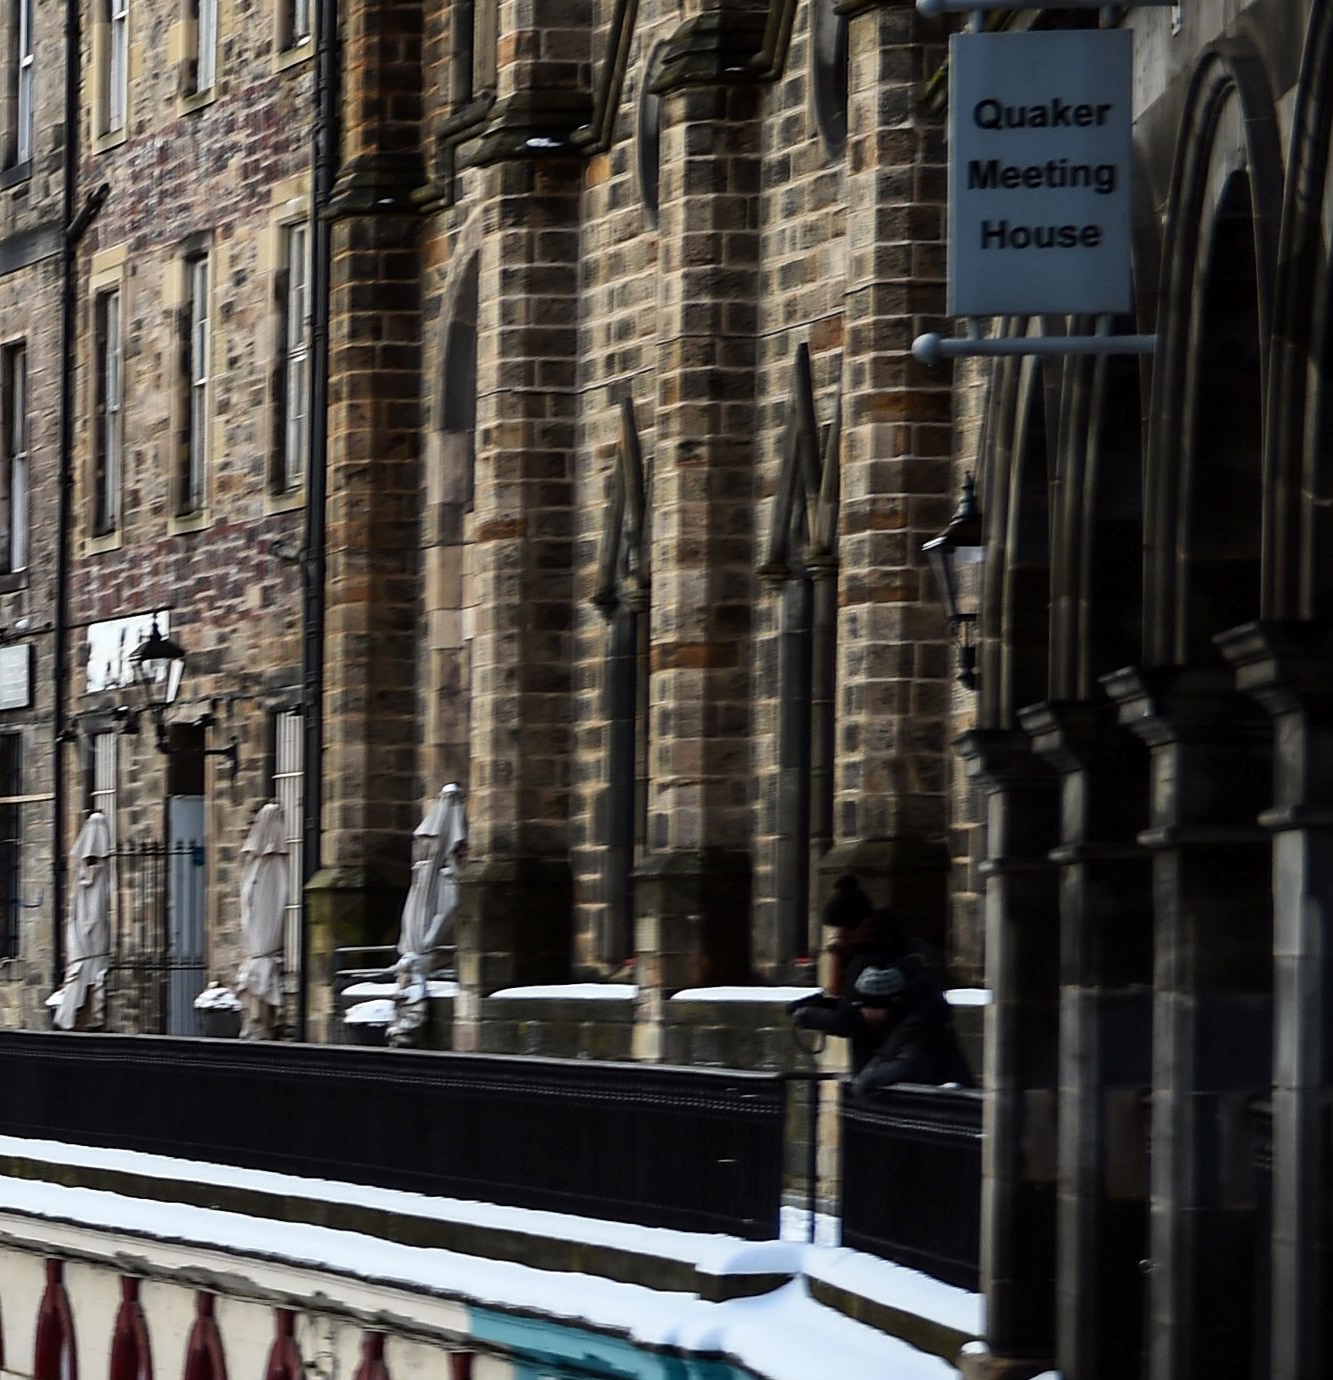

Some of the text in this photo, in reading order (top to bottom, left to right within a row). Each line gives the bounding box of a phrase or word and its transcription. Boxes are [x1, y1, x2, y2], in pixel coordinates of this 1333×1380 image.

[973, 97, 1113, 130] Quaker
[967, 158, 1118, 194] Meeting
[980, 220, 1102, 250] House
